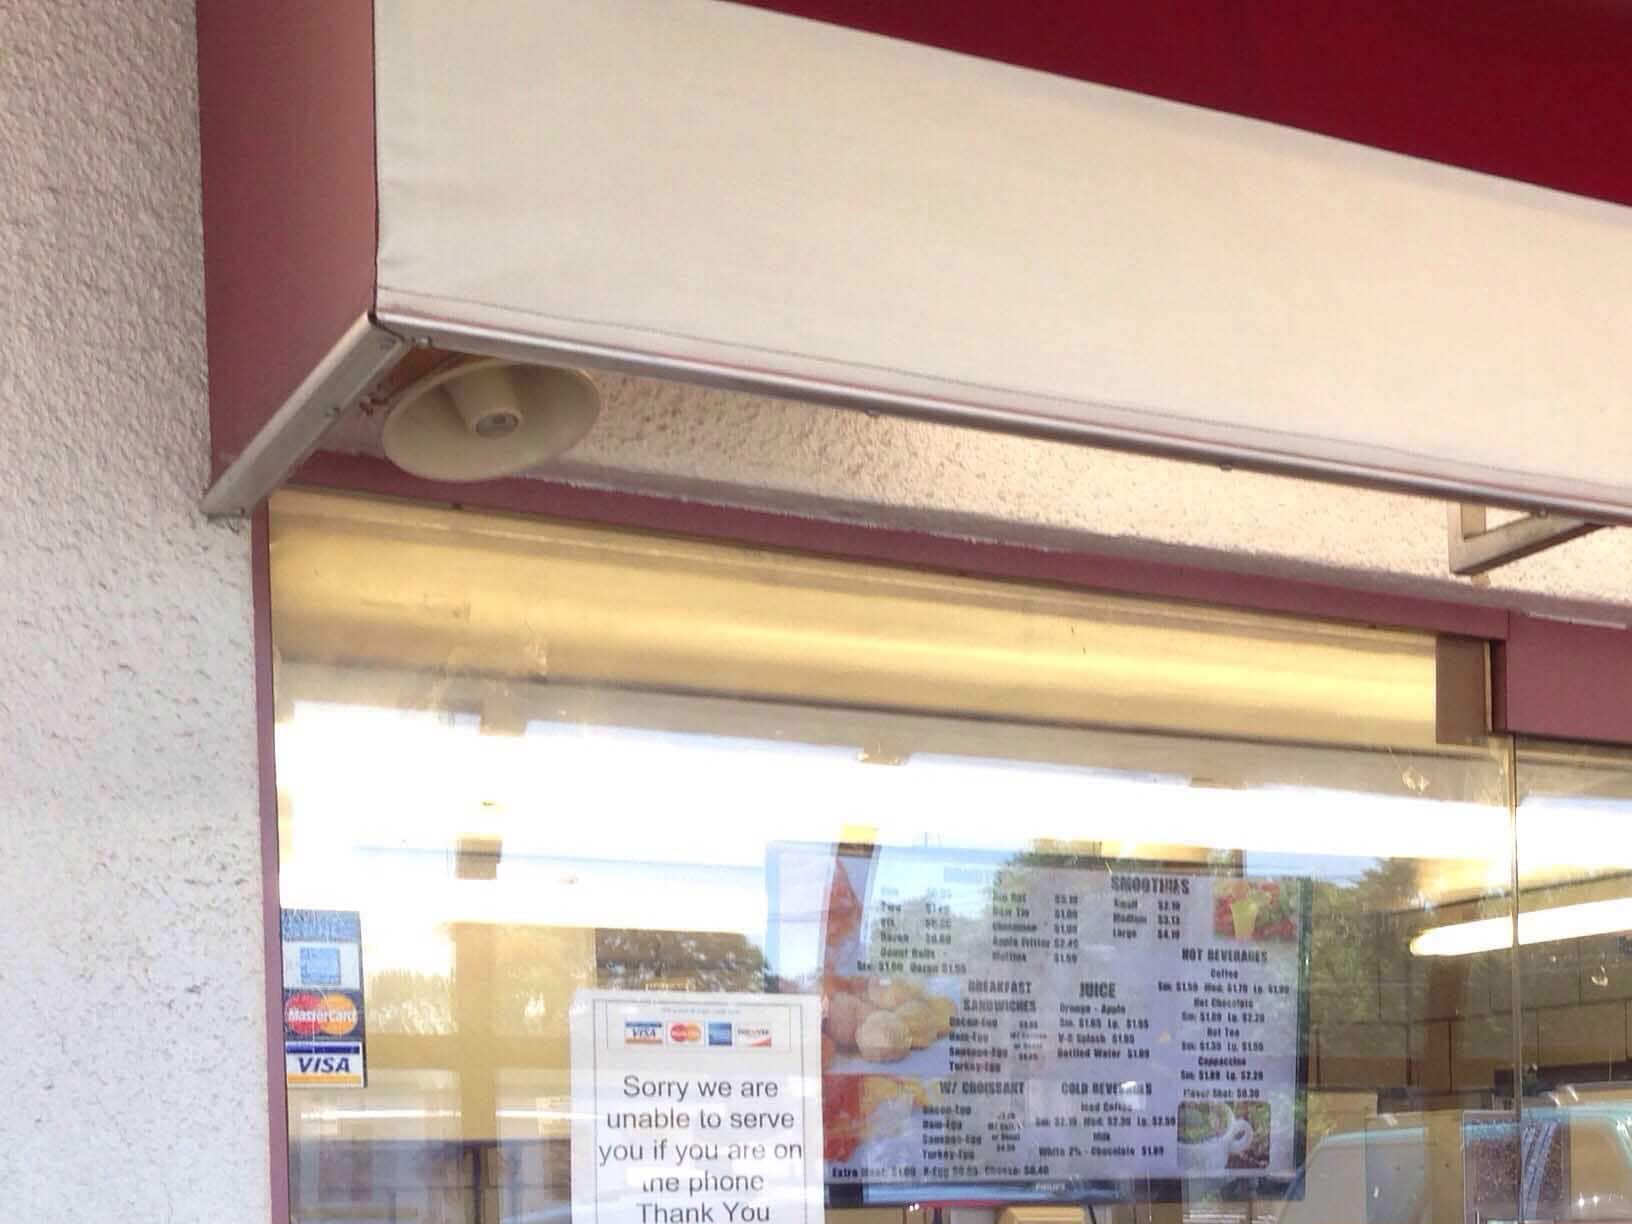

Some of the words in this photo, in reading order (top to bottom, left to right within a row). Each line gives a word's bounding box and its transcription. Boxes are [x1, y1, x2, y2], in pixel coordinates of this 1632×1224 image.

[1111, 876, 1190, 894] SMOOTHIES
[1182, 948, 1202, 962] HOT
[1207, 949, 1268, 962] BEVERAGES
[1210, 968, 1238, 979] Coffee
[968, 980, 1032, 994] BREAKFAST
[1079, 981, 1116, 998] JUICE
[963, 999, 1036, 1013] SANDWICHES
[288, 1007, 355, 1022] MasterCard
[632, 1028, 656, 1038] VISA
[299, 1057, 350, 1073] VISA
[624, 1075, 688, 1102] Sorry
[697, 1081, 732, 1098] we
[741, 1081, 779, 1098] are
[962, 1082, 1024, 1095] CROISSANT
[1061, 1082, 1088, 1095] COLD
[607, 1108, 690, 1129] unable
[700, 1111, 722, 1129] to
[730, 1112, 795, 1129] serve
[599, 1143, 643, 1166] you
[653, 1139, 668, 1161] if
[675, 1143, 718, 1166] you
[727, 1143, 766, 1160] are
[774, 1143, 802, 1160] on
[689, 1170, 764, 1196] phone
[636, 1203, 714, 1224] Thank
[722, 1202, 771, 1223] You
